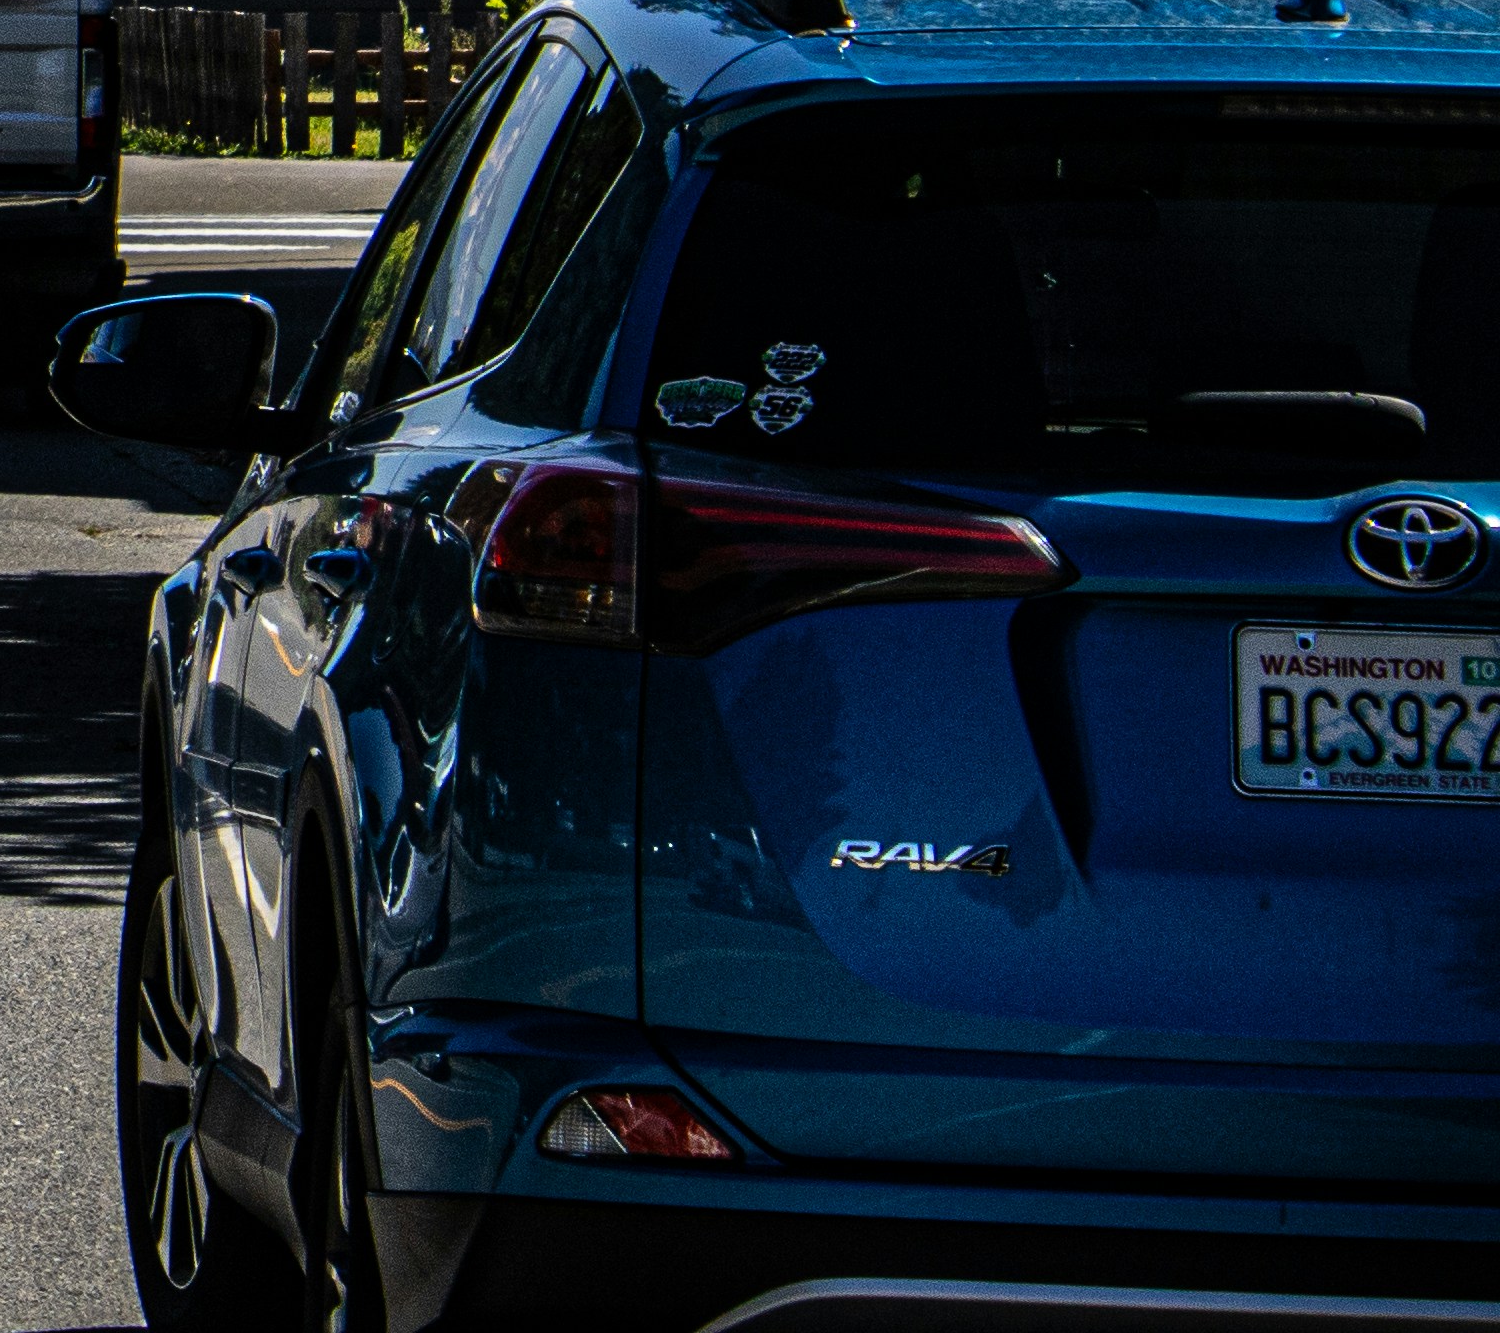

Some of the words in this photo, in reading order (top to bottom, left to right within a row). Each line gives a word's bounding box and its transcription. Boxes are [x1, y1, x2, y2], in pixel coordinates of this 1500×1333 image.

[758, 395, 803, 417] 56
[1259, 654, 1446, 681] WASHINGTON
[1466, 659, 1497, 679] 10
[1328, 771, 1431, 789] EVERGREEN
[1438, 775, 1492, 791] STATE
[829, 838, 1010, 877] RAV4
